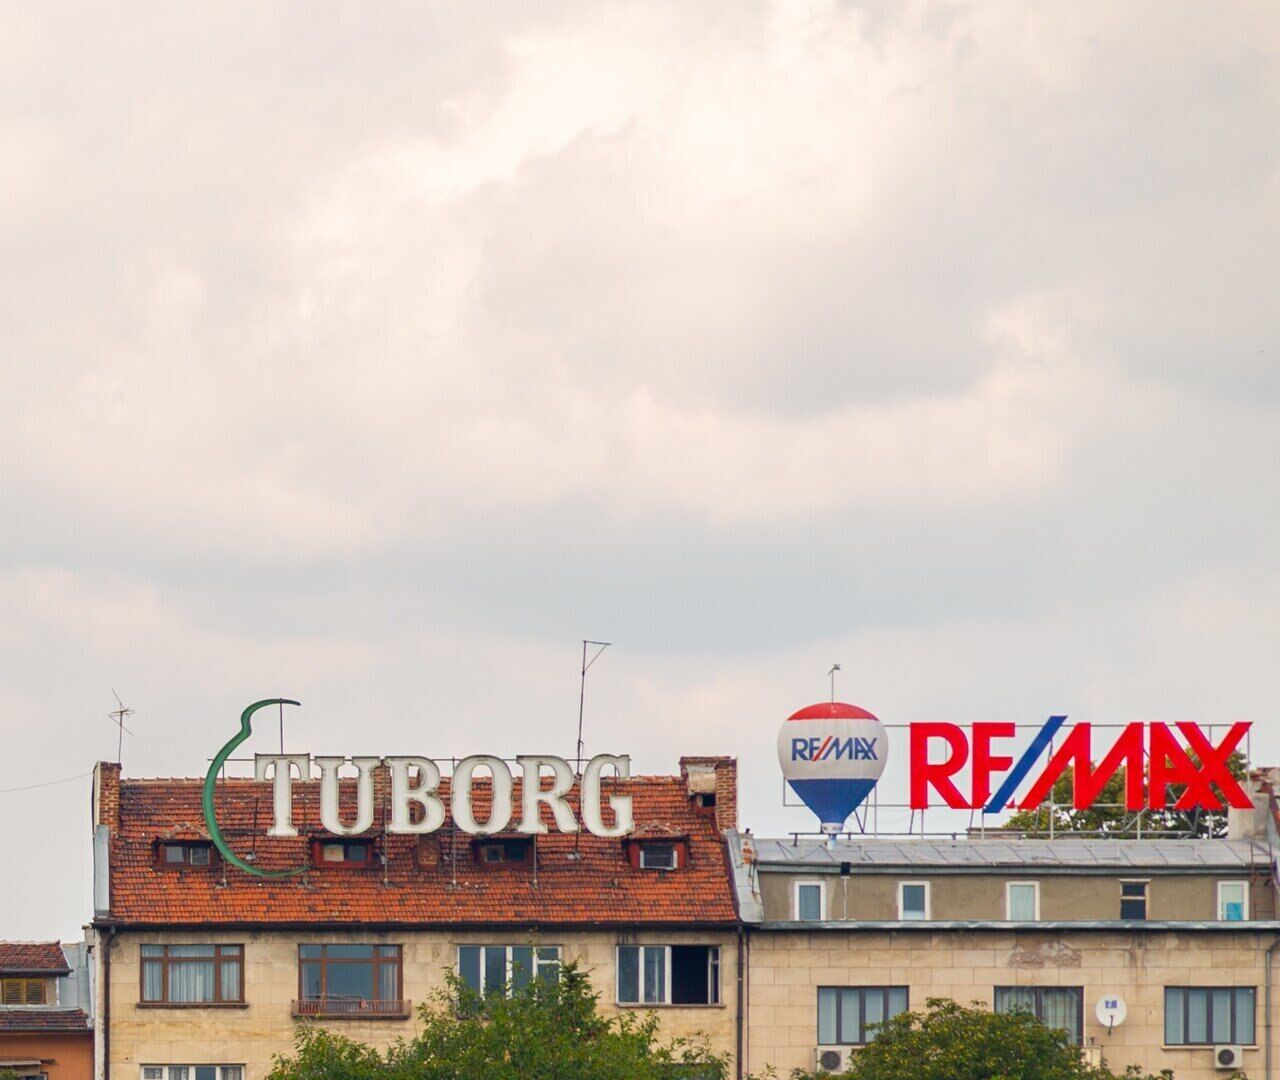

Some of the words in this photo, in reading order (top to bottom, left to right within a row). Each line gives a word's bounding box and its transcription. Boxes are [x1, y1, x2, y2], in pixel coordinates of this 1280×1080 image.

[791, 735, 878, 761] RE/MAX
[909, 715, 1255, 814] RE/MAX
[254, 753, 635, 837] TUBORG
